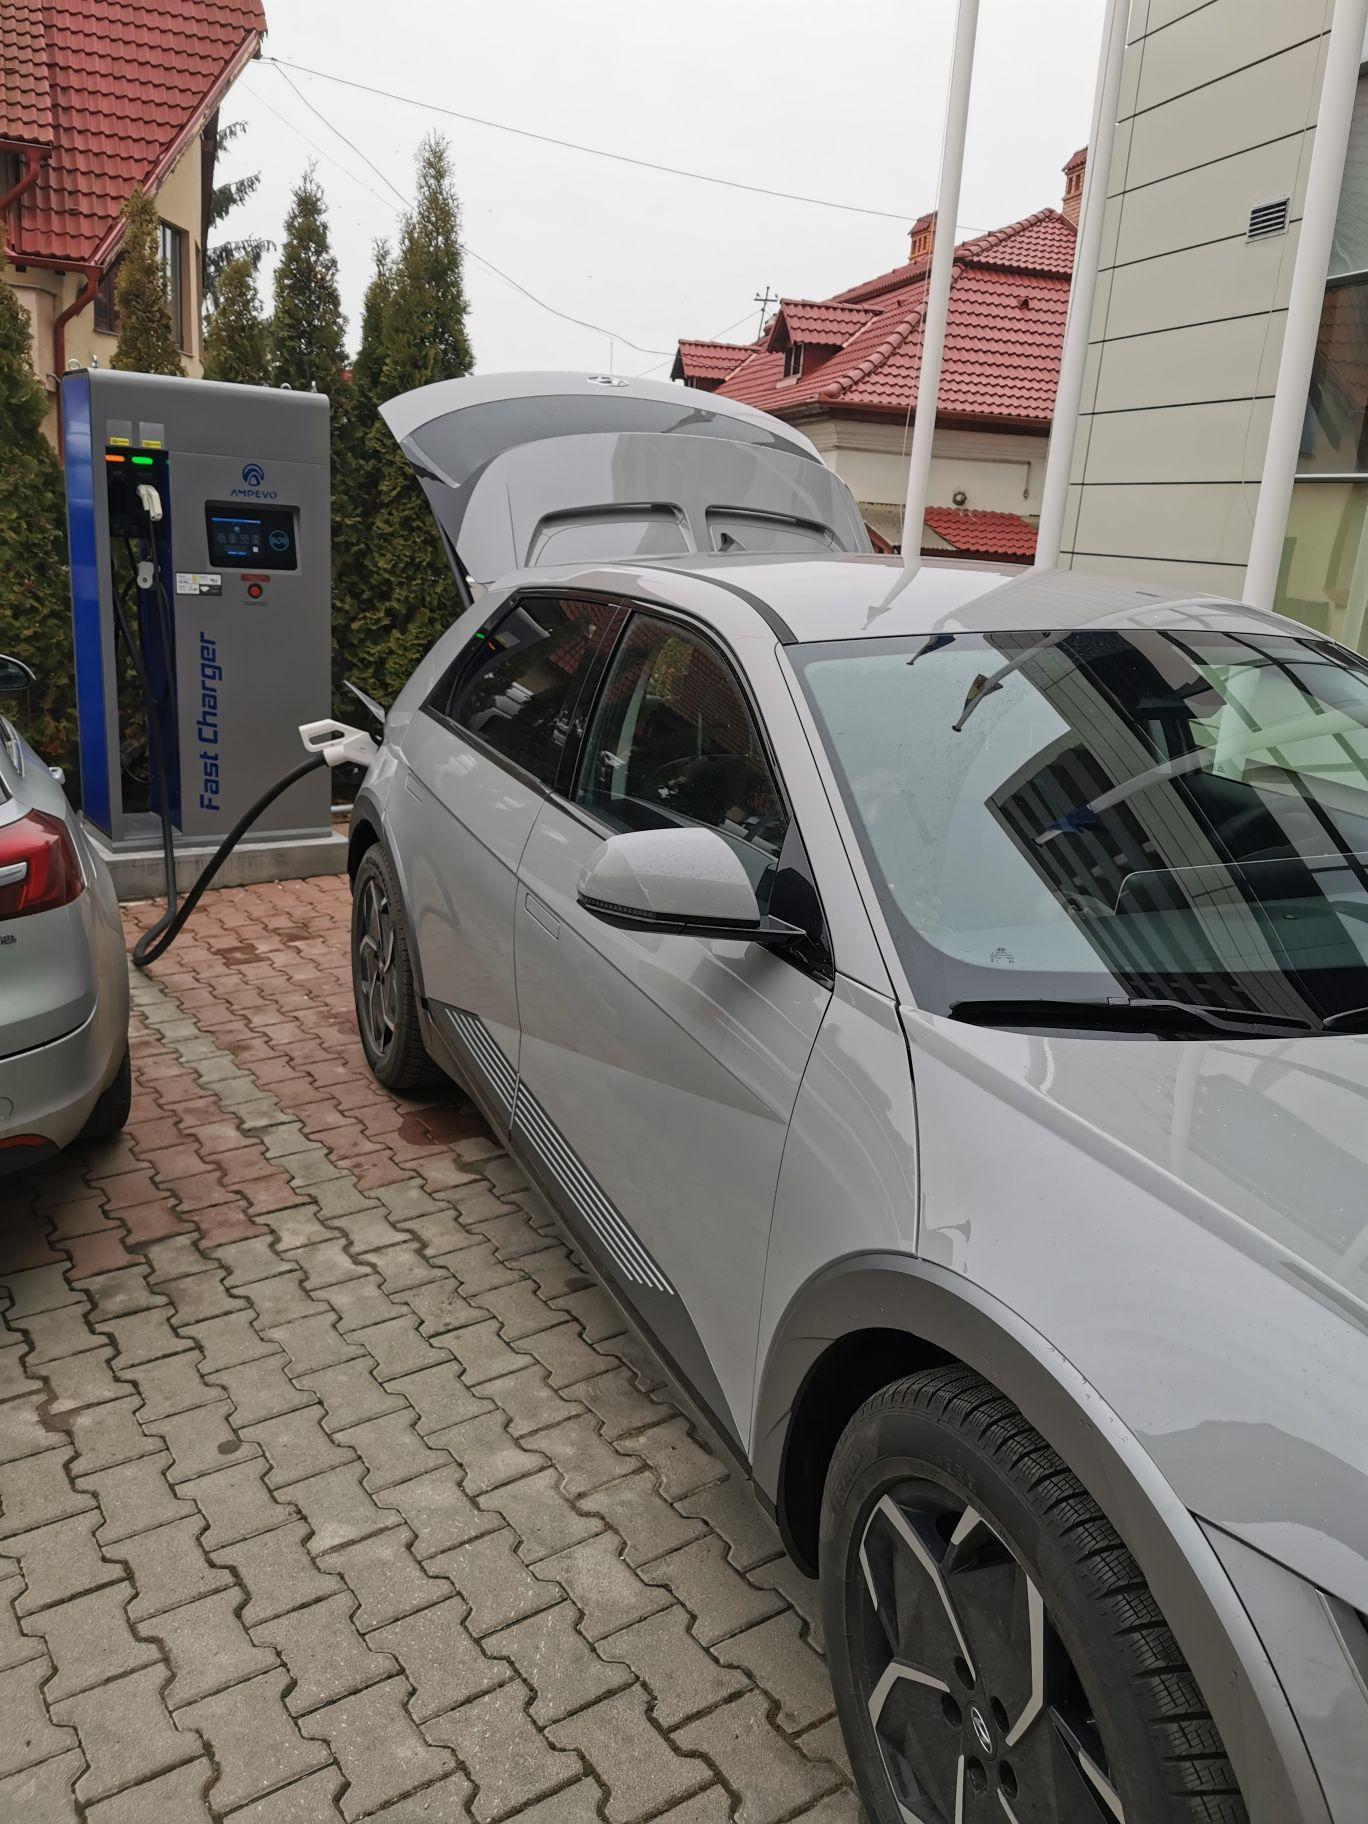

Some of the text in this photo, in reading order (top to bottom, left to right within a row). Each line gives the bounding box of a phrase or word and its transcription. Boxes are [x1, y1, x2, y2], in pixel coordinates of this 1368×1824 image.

[230, 489, 278, 500] AMPEVO
[197, 631, 222, 811] Fast Charger
